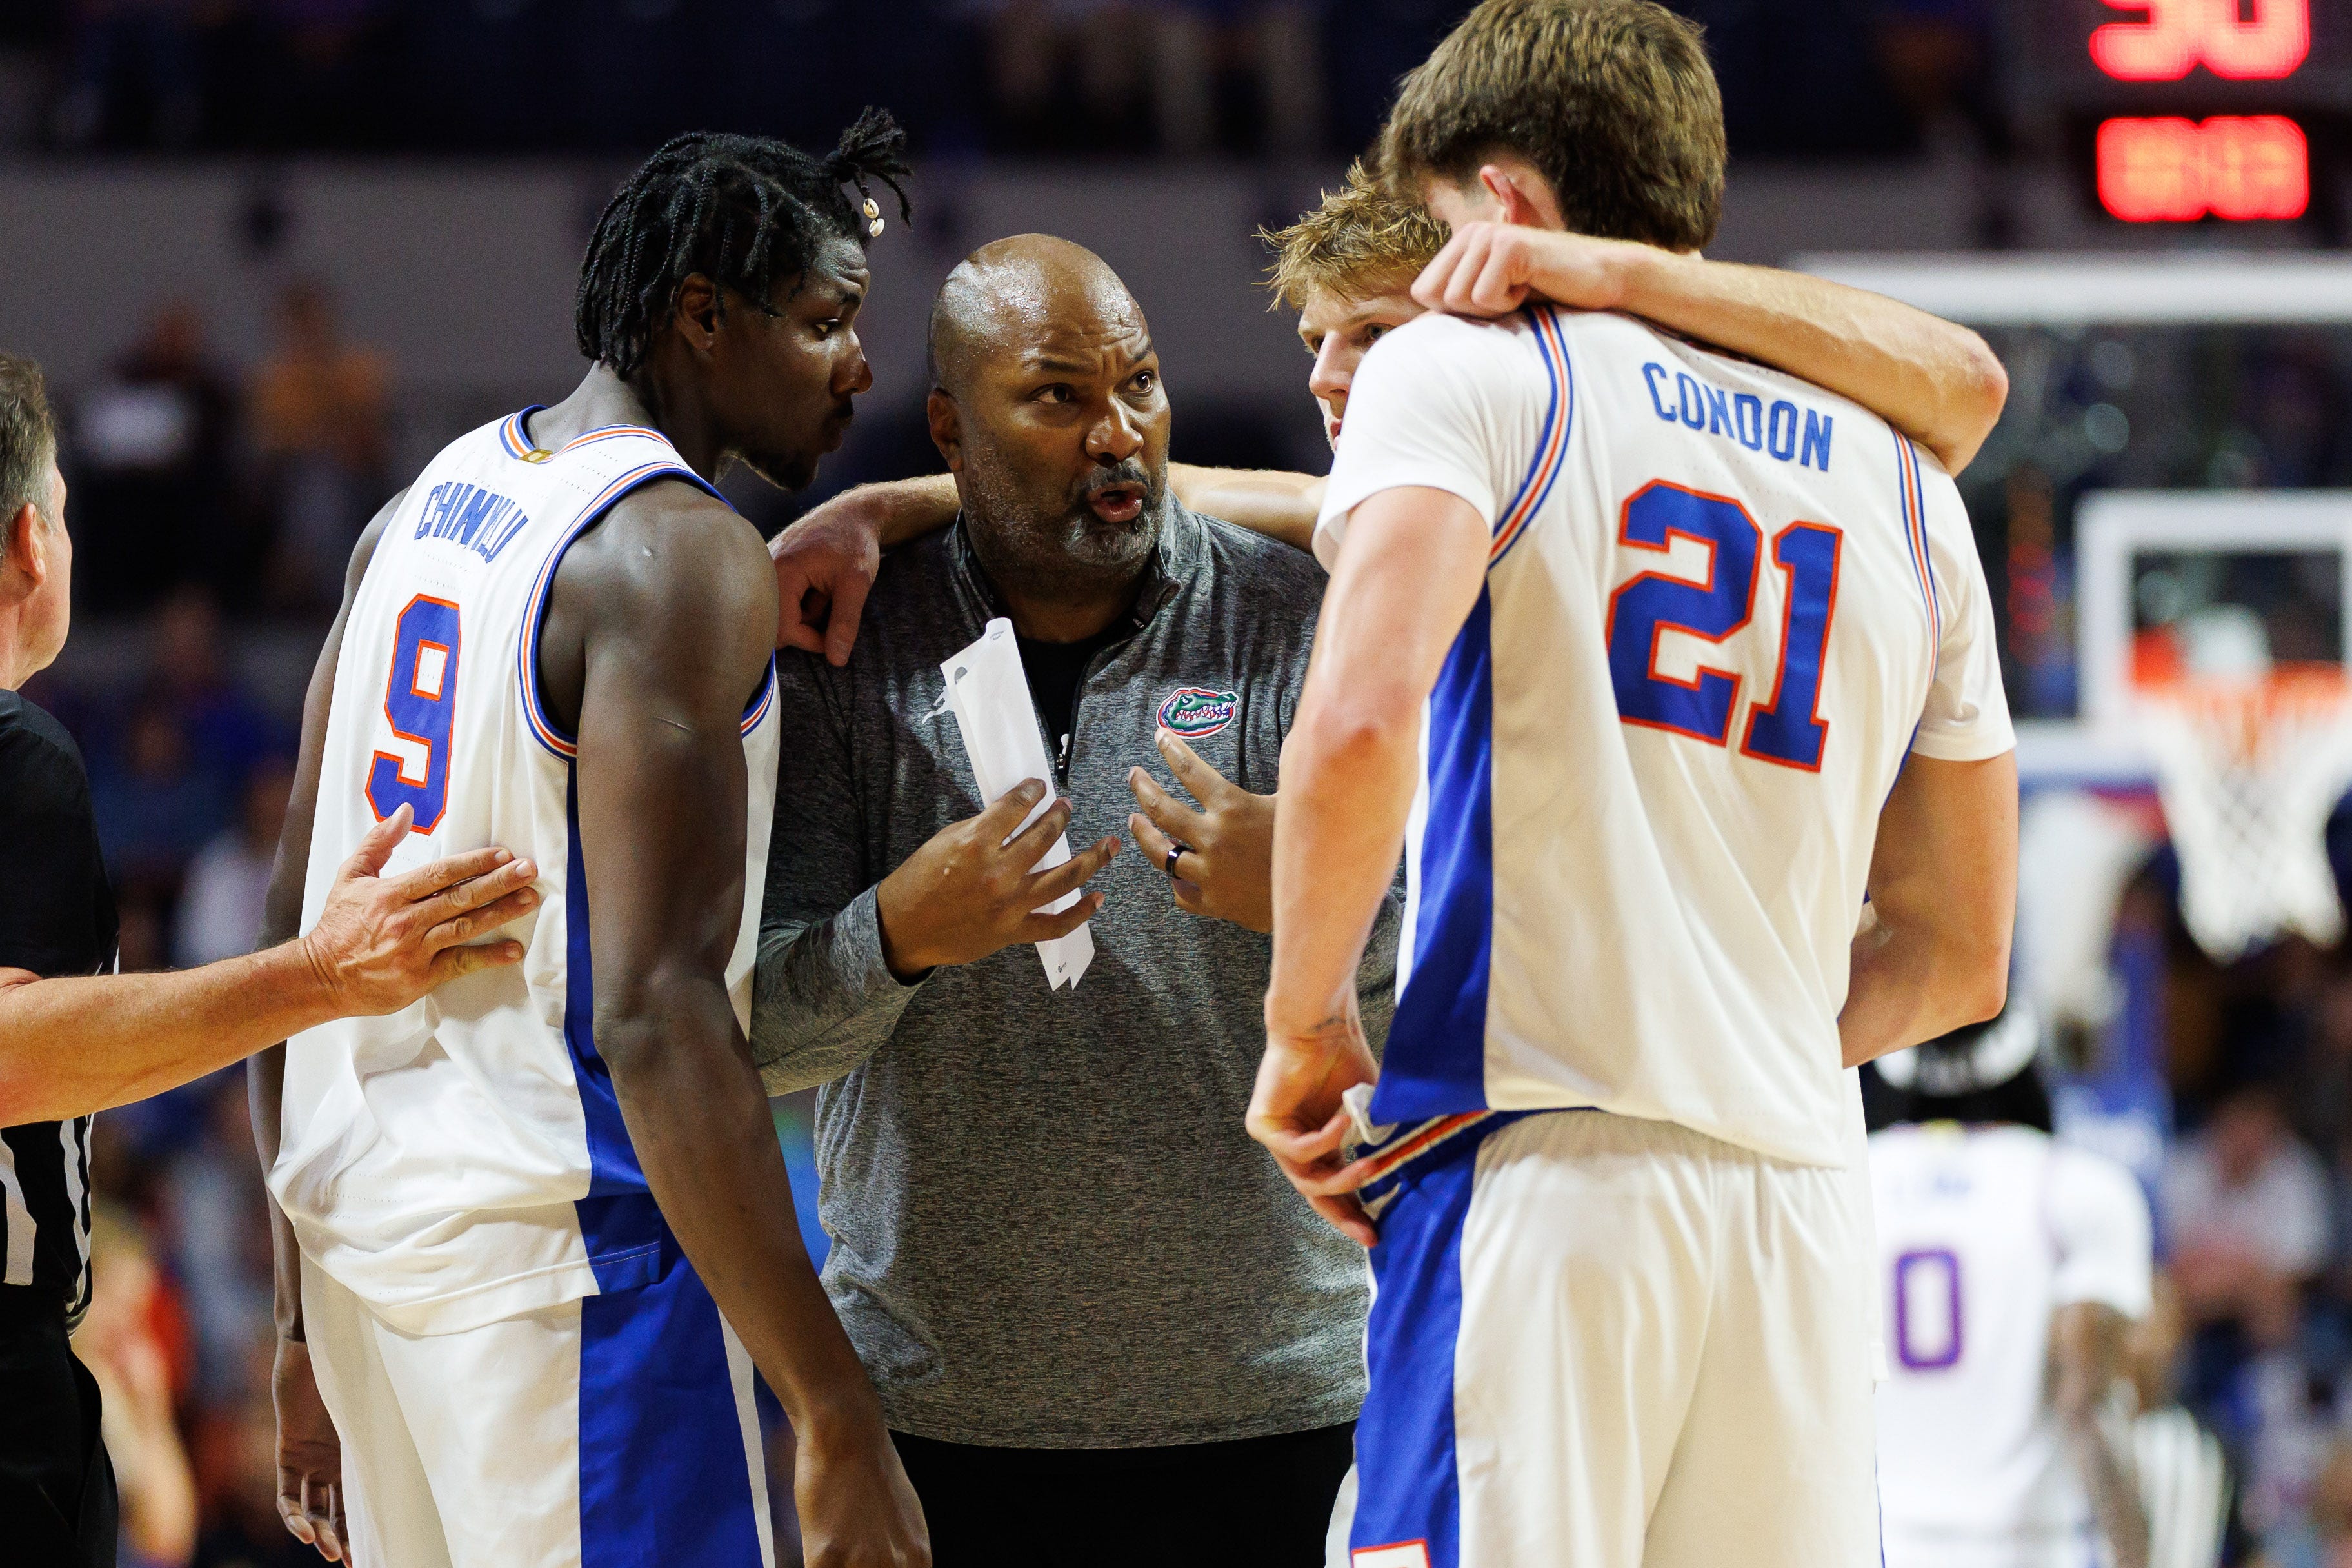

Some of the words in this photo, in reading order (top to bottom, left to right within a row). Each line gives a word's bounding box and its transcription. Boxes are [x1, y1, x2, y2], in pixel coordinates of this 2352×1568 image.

[1642, 362, 1833, 471] CONDON
[365, 593, 461, 835] 9
[1605, 478, 1843, 773] 21
[1894, 1246, 1963, 1371] 0
